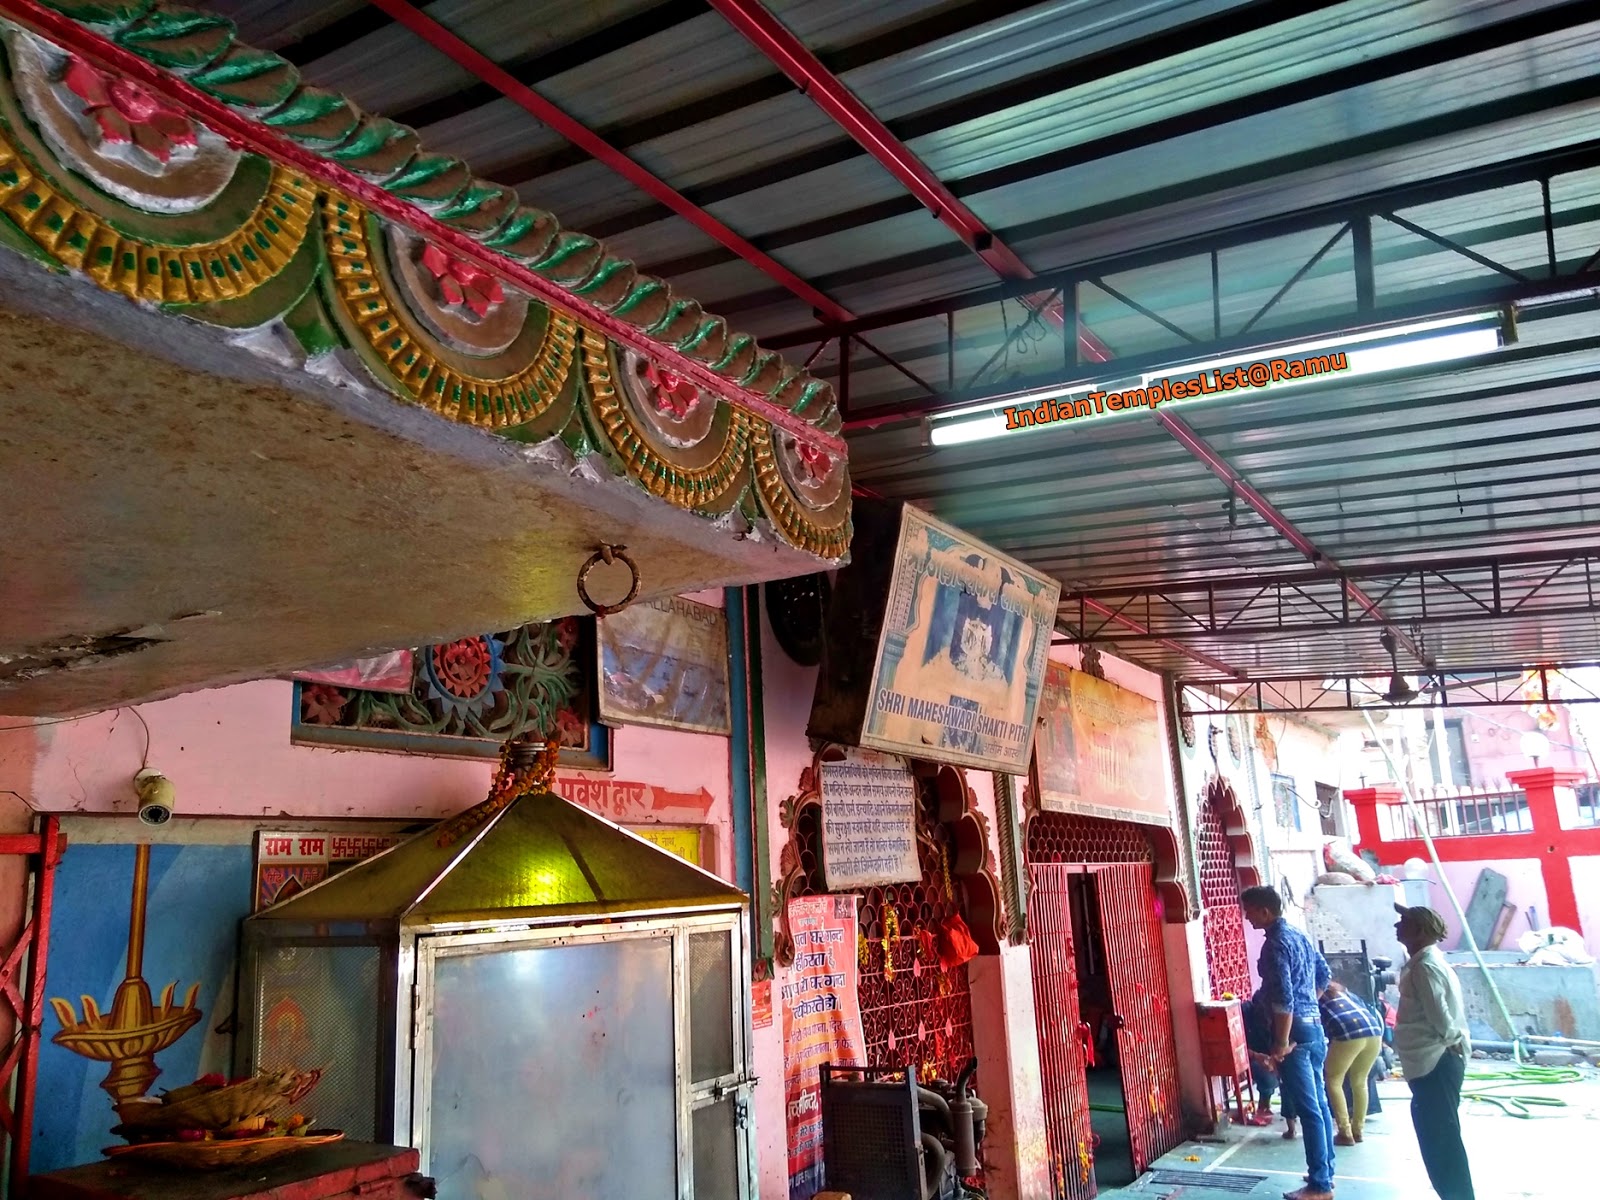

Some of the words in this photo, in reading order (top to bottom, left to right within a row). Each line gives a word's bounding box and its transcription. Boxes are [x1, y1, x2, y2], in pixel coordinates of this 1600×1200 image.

[877, 688, 906, 715] SHRI
[907, 697, 977, 733] MAHESHWARI
[976, 715, 1008, 739] SHAKTI
[1008, 723, 1029, 744] PITH
[612, 780, 647, 816] द्वार
[264, 837, 293, 856] राम
[298, 837, 326, 856] राम
